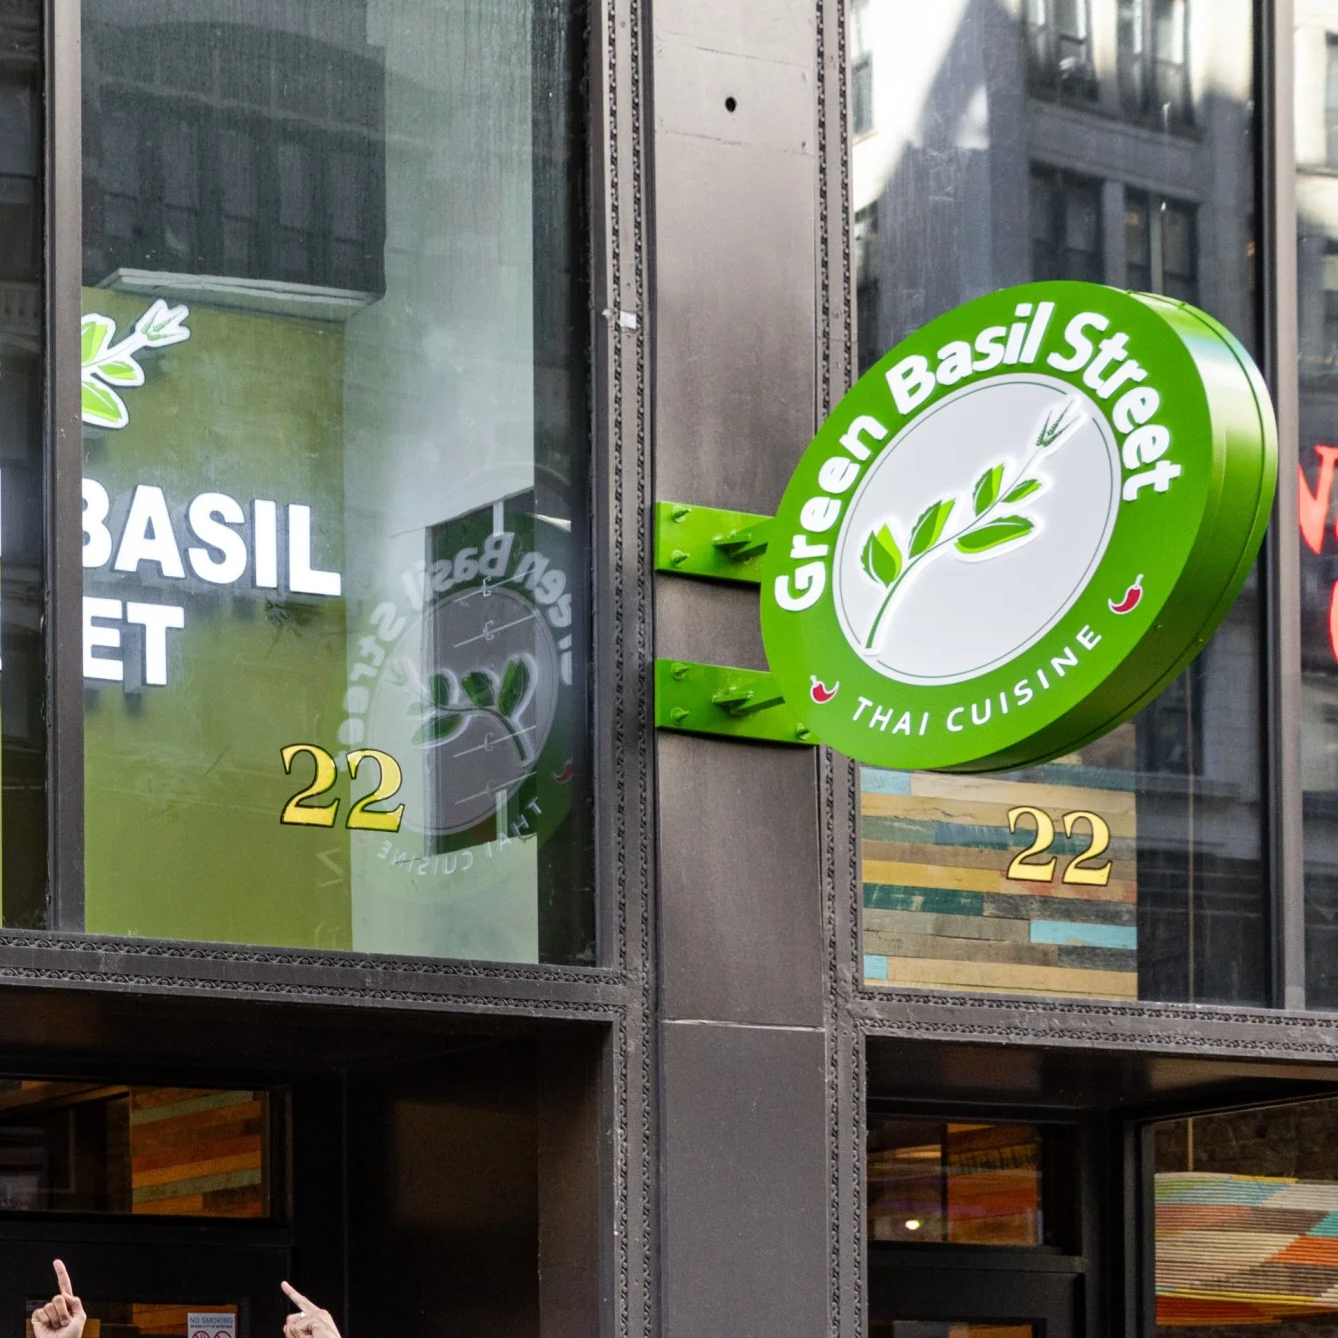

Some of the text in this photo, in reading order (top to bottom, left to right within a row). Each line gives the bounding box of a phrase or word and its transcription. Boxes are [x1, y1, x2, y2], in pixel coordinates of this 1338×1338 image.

[773, 413, 889, 614] Green
[885, 301, 1055, 416] Basil
[1047, 311, 1183, 502] Street
[851, 624, 1103, 737] THAI CUISINE
[279, 743, 406, 833] 22
[1006, 805, 1114, 888] 22
[189, 1316, 233, 1324] NO SMOKING
